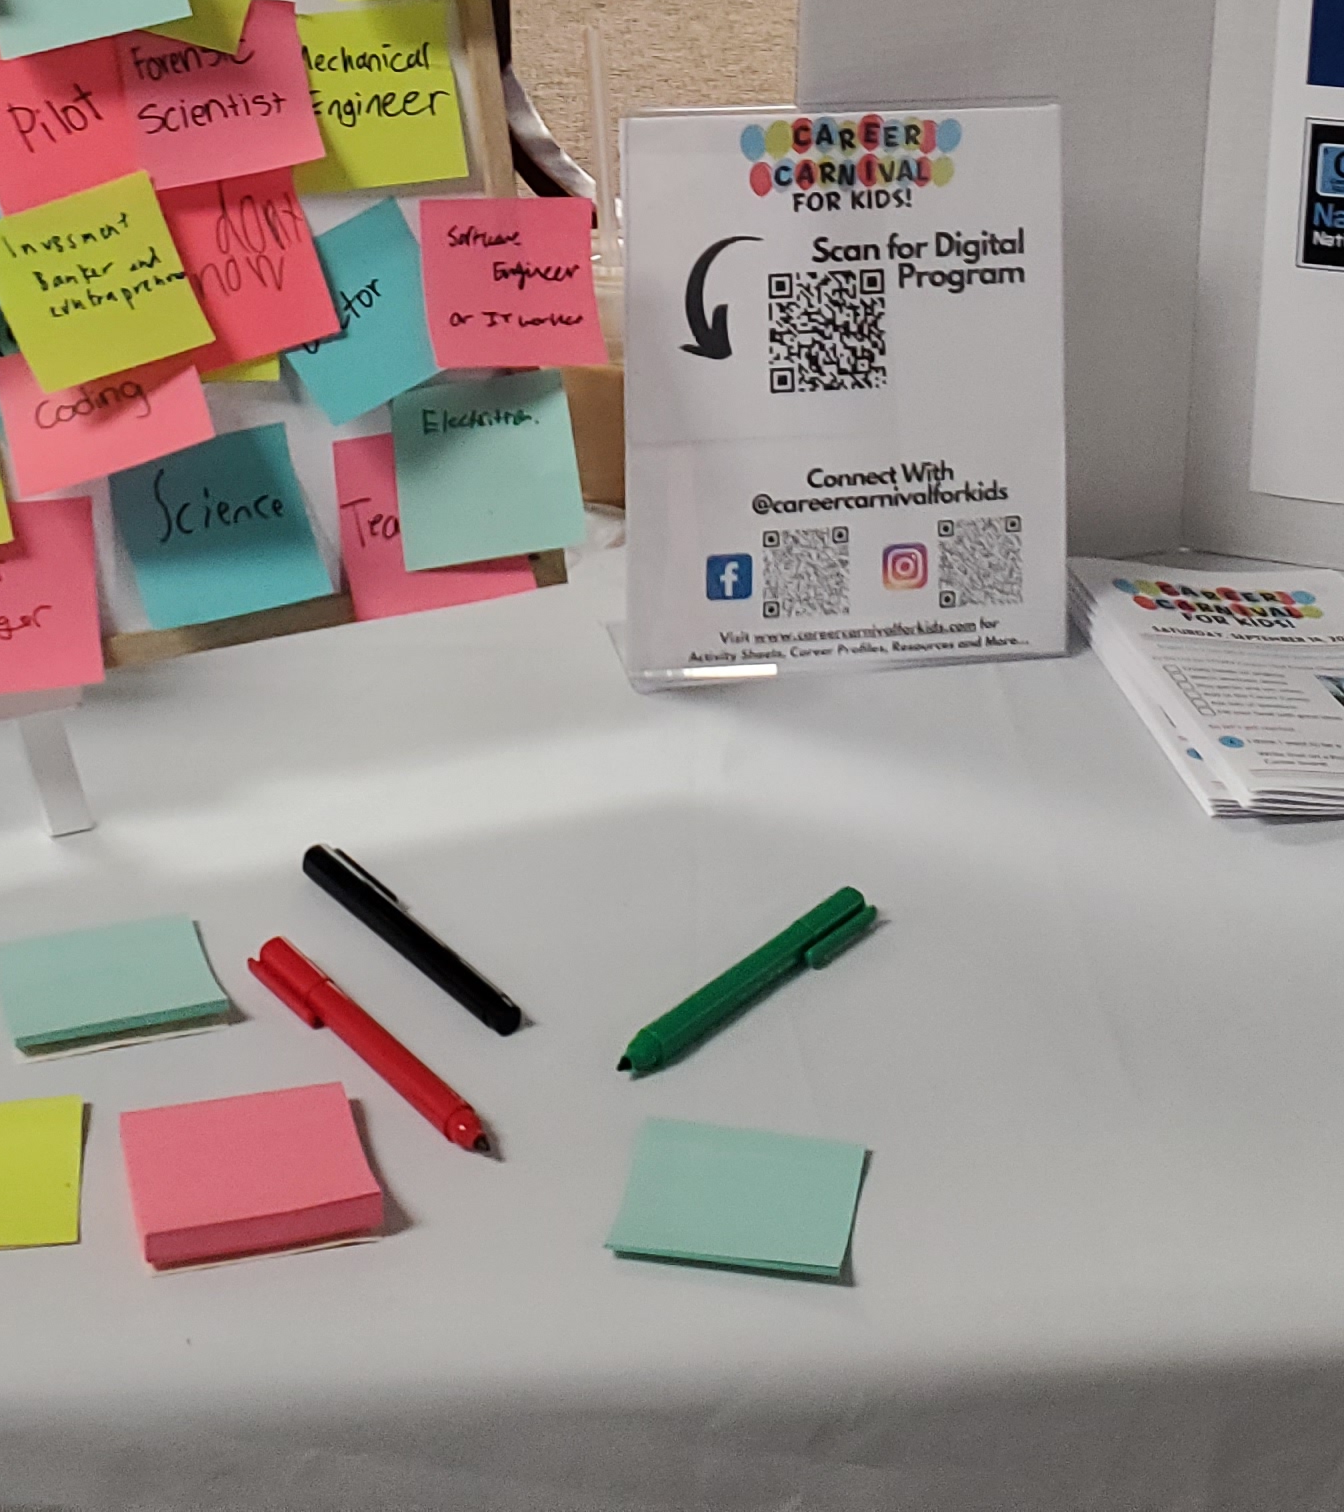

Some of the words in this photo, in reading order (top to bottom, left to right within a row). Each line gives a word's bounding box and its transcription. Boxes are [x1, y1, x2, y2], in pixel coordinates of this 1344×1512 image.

[7, 82, 106, 154] Pilot
[136, 92, 289, 136] Scientist
[792, 120, 920, 151] CAREER
[774, 157, 930, 188] CARNIVAL
[792, 191, 842, 213] FOR
[850, 187, 914, 210] KIDS!
[811, 233, 881, 264] Scan
[887, 232, 929, 262] for
[934, 226, 1026, 265] Digital
[897, 263, 1026, 295] Program
[806, 465, 898, 490] Connect
[902, 459, 955, 484] With
[153, 466, 286, 544] Science
